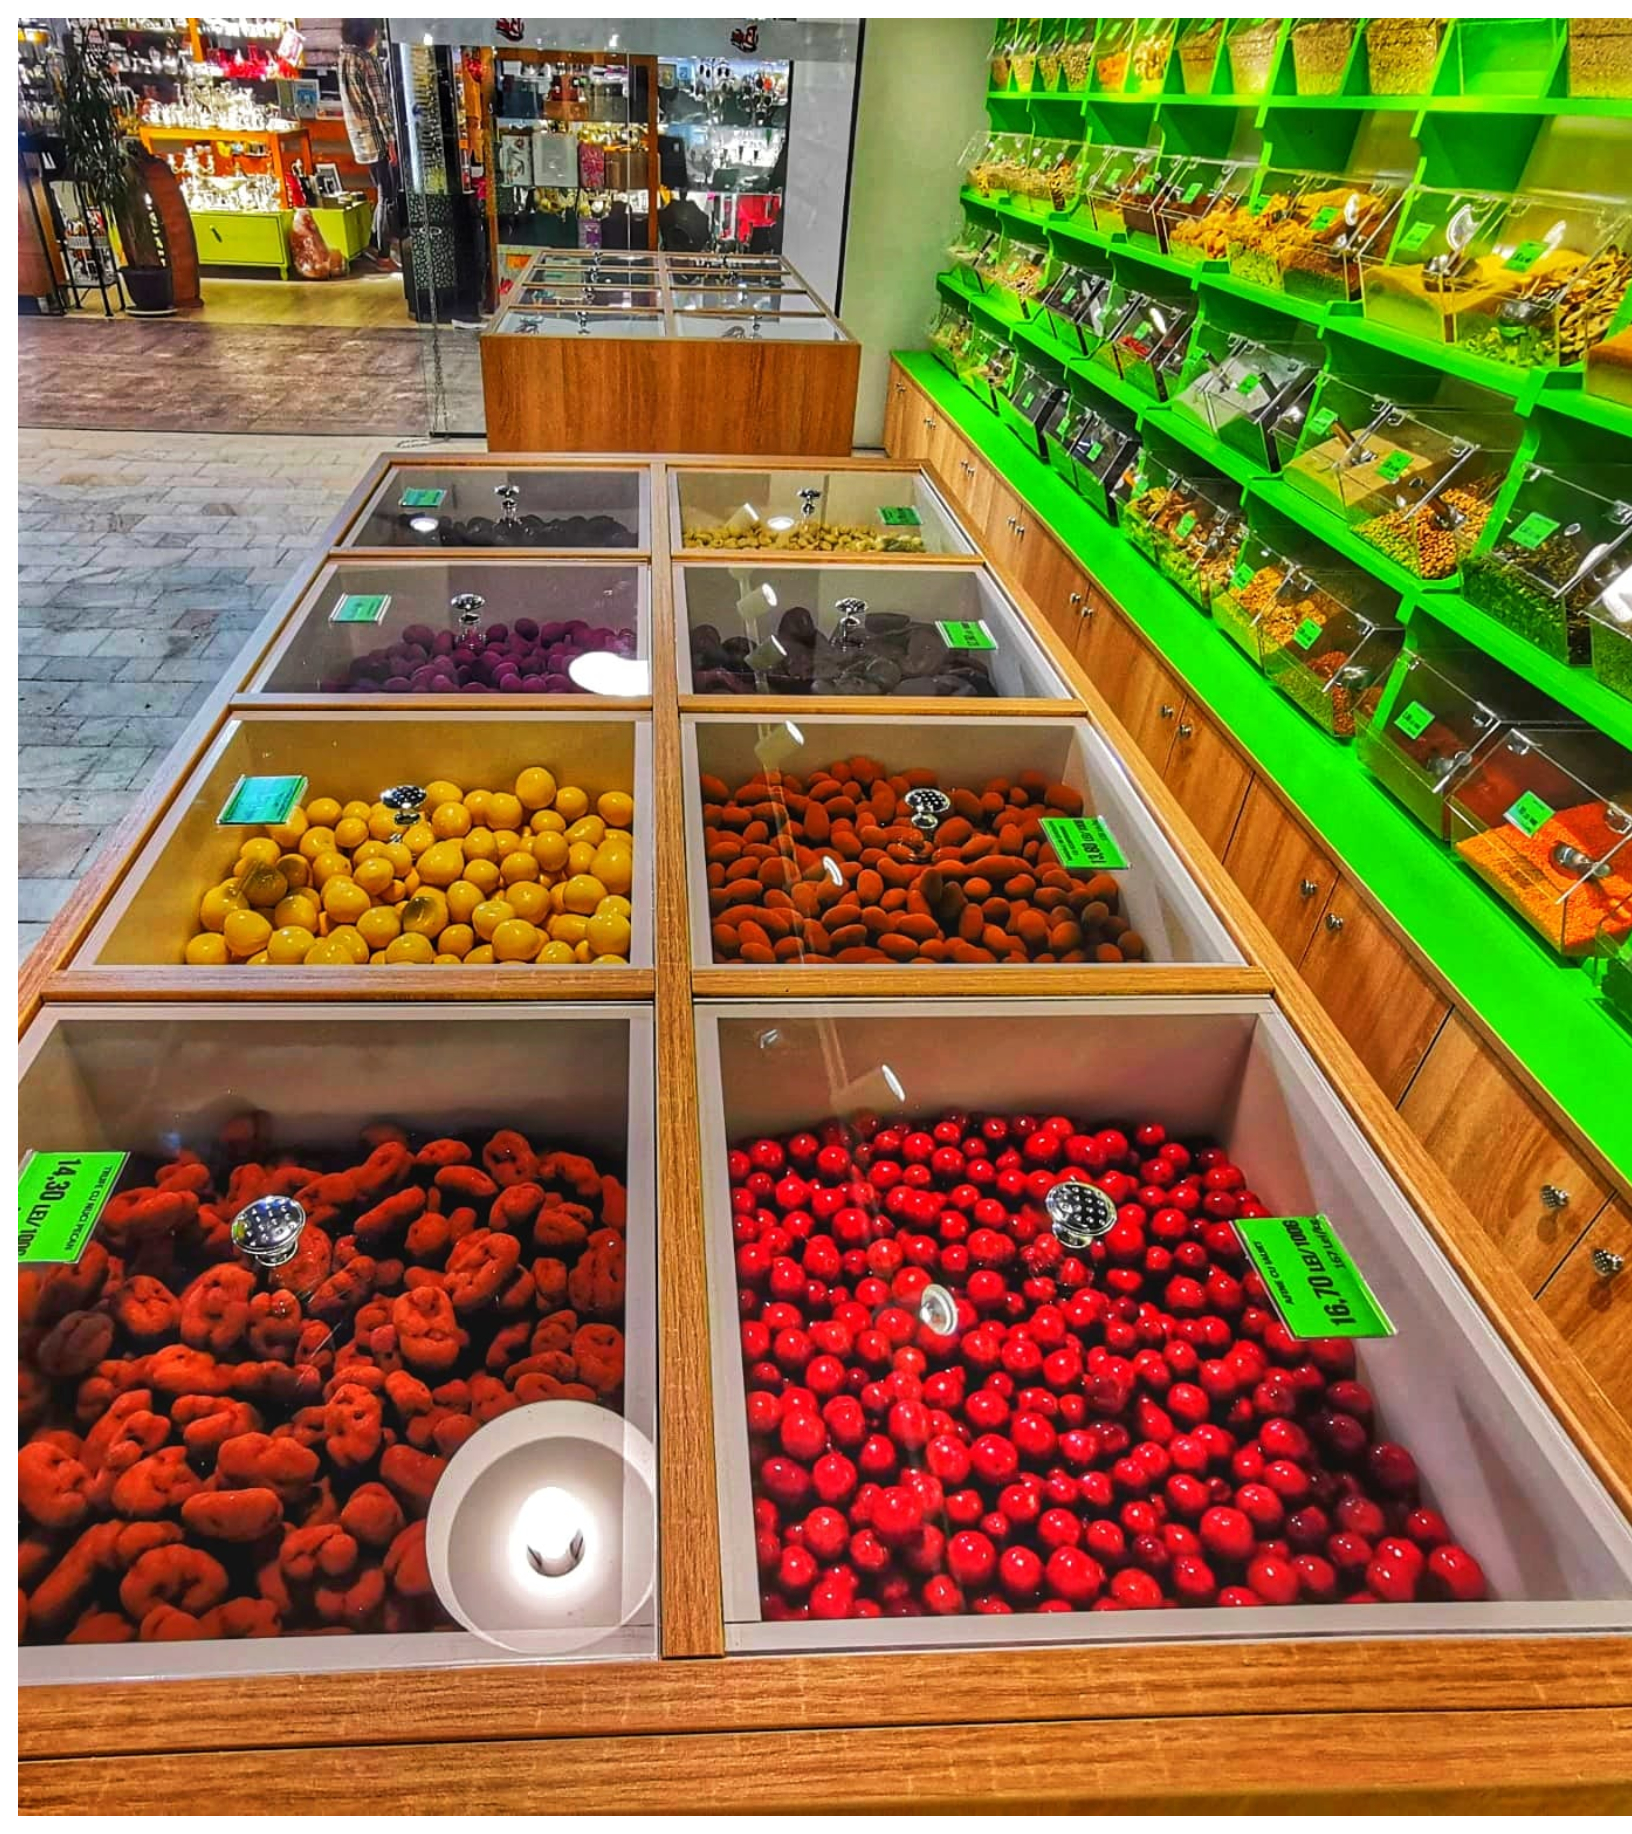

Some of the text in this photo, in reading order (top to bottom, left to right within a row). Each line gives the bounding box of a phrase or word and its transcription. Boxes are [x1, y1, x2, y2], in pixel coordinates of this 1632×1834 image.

[36, 1157, 84, 1200] 14,30
[85, 1190, 102, 1201] CU
[75, 1202, 96, 1221] NUCI
[62, 1223, 85, 1251] PECAN
[1264, 1265, 1280, 1277] CU
[1304, 1275, 1361, 1326] 16,70
